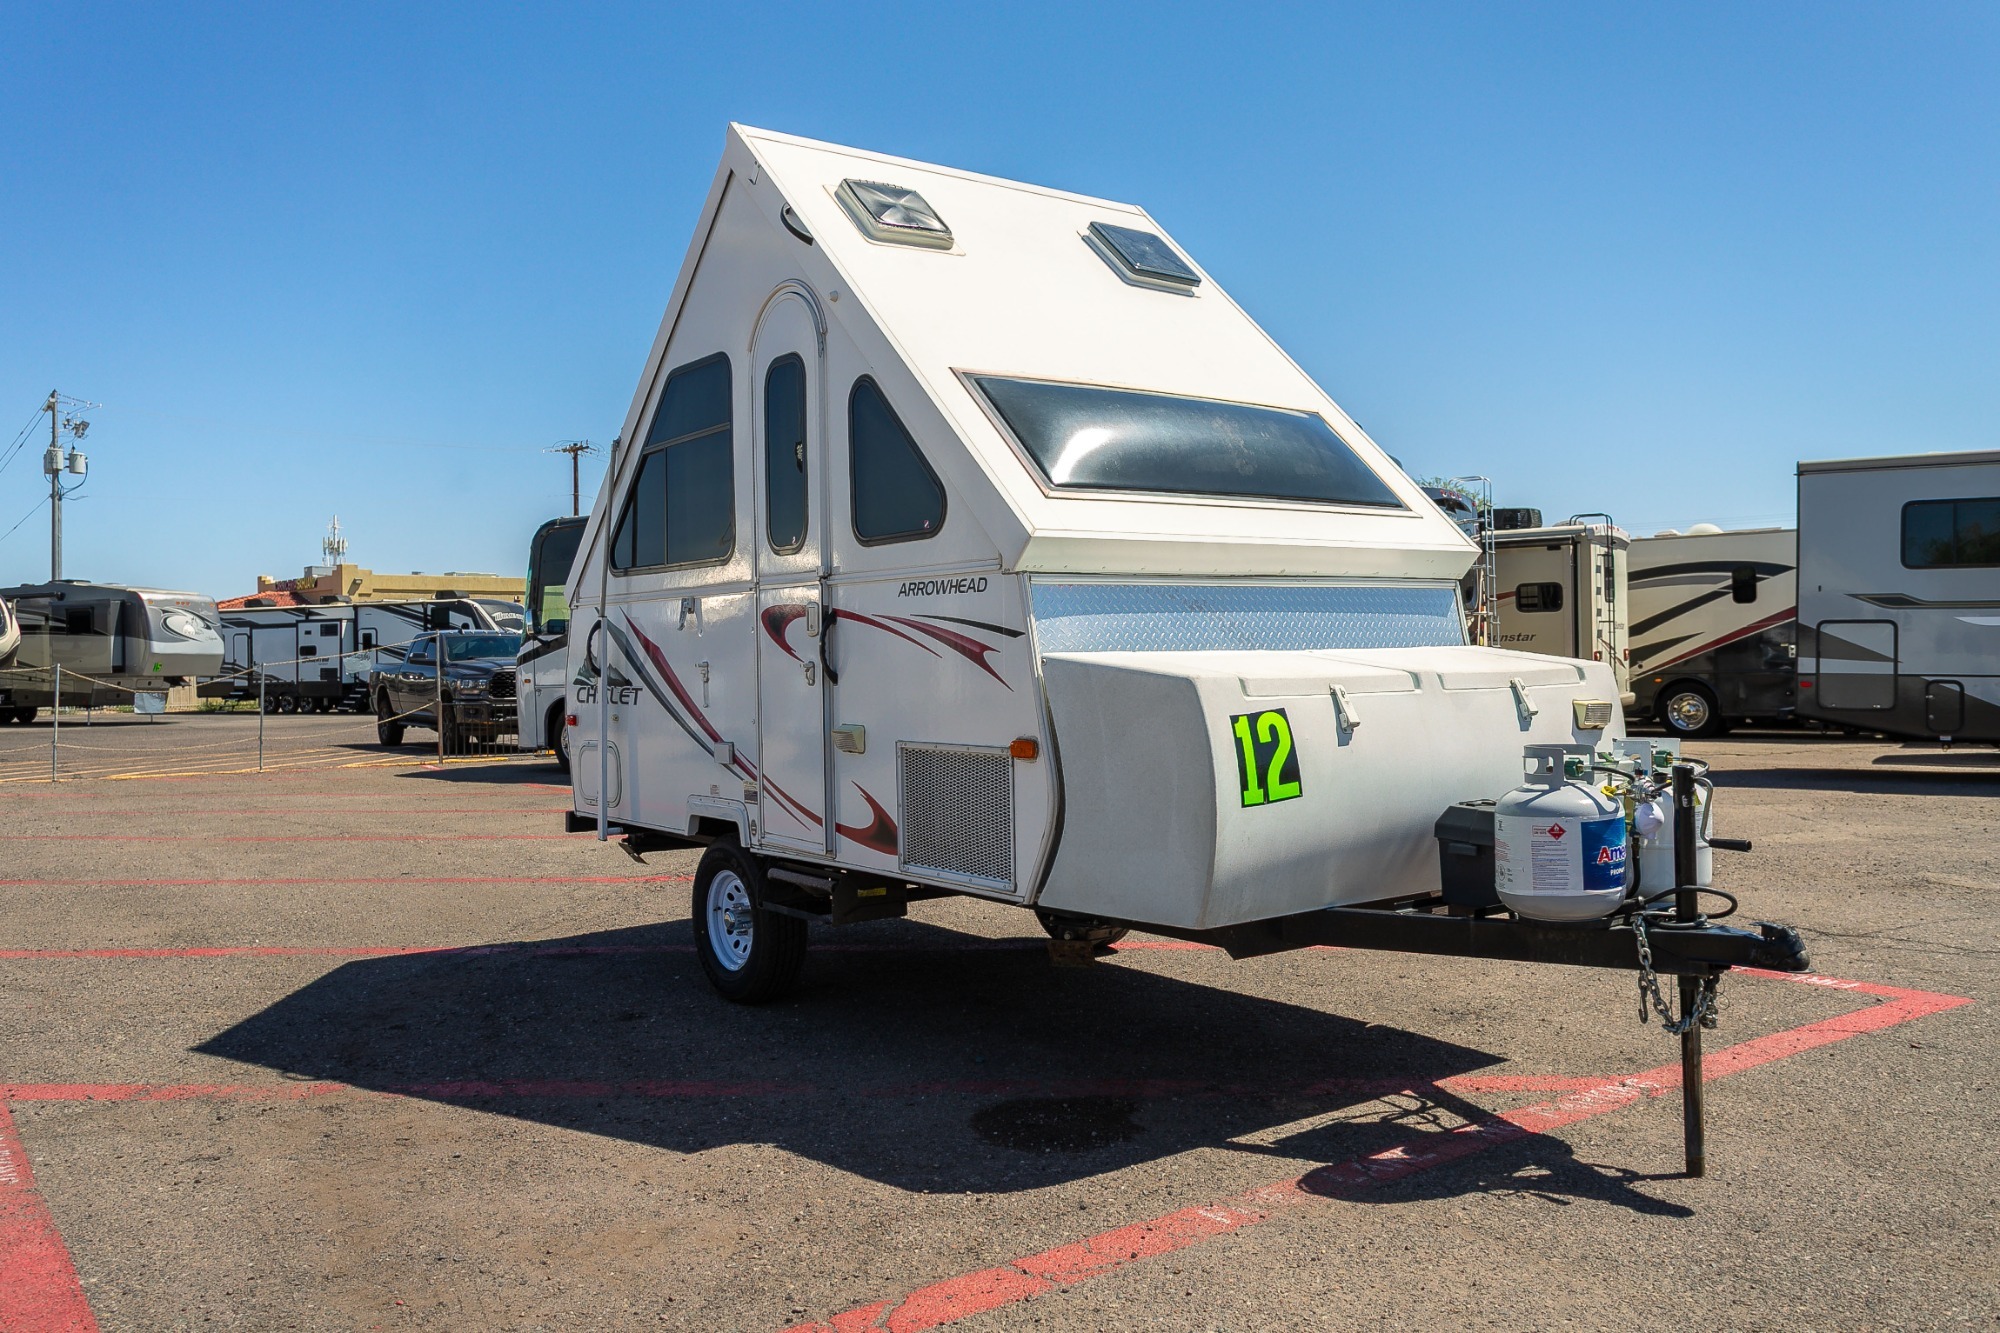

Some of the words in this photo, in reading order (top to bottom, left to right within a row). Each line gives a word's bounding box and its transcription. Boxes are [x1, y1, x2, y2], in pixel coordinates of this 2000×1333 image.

[898, 577, 988, 597] ARROWHEAD
[576, 686, 643, 705] CHLET
[1234, 711, 1300, 806] 12
